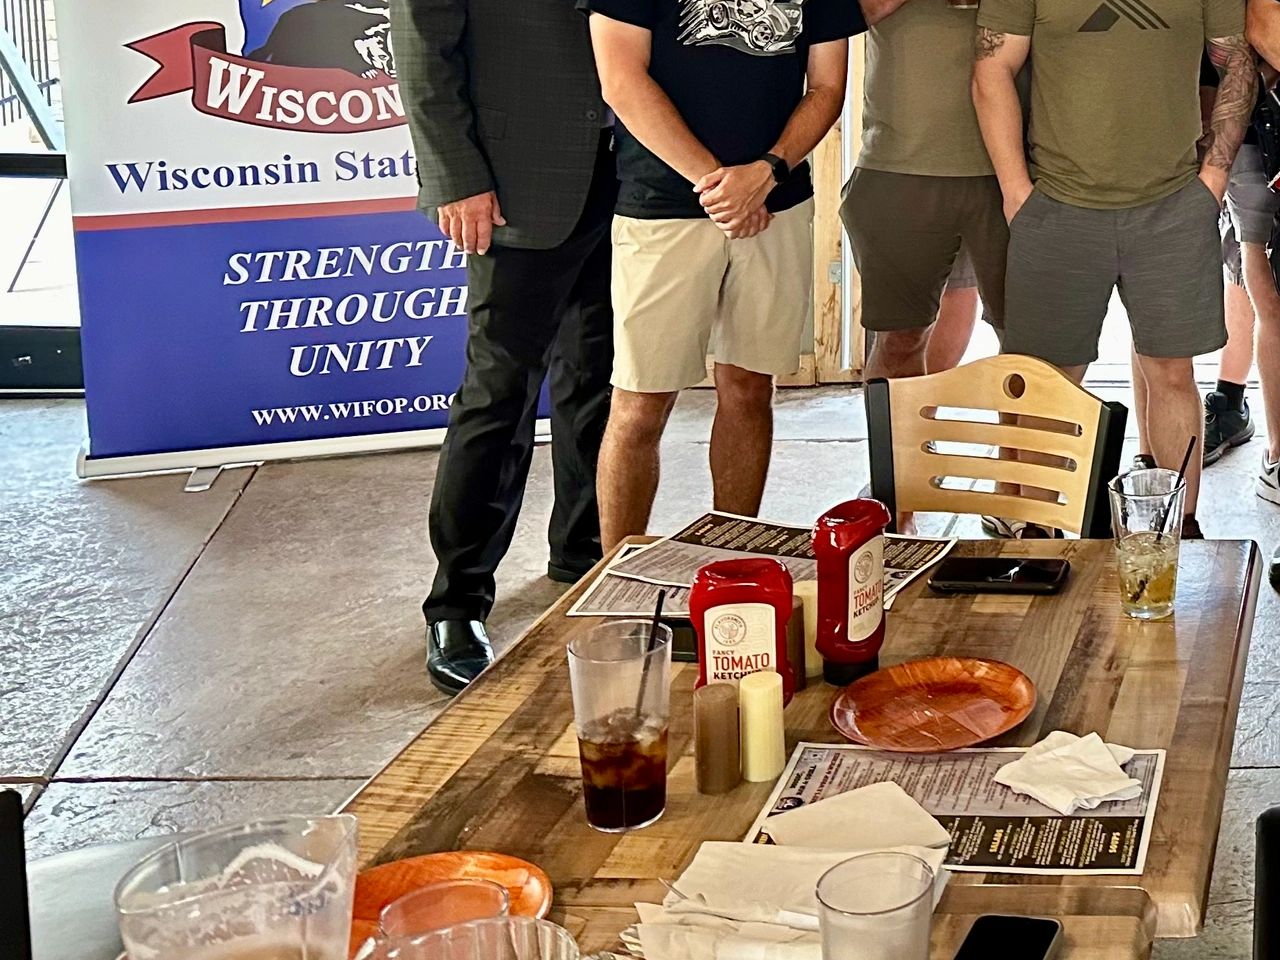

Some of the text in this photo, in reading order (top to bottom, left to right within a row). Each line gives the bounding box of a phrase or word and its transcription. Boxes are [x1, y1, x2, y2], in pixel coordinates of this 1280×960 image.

[104, 154, 320, 194] Wisconsin
[223, 239, 469, 286] STRENGTH
[240, 286, 469, 333] THROUGH
[290, 336, 434, 377] UNITY
[713, 653, 770, 671] TOMATO
[713, 669, 762, 680] KETCH
